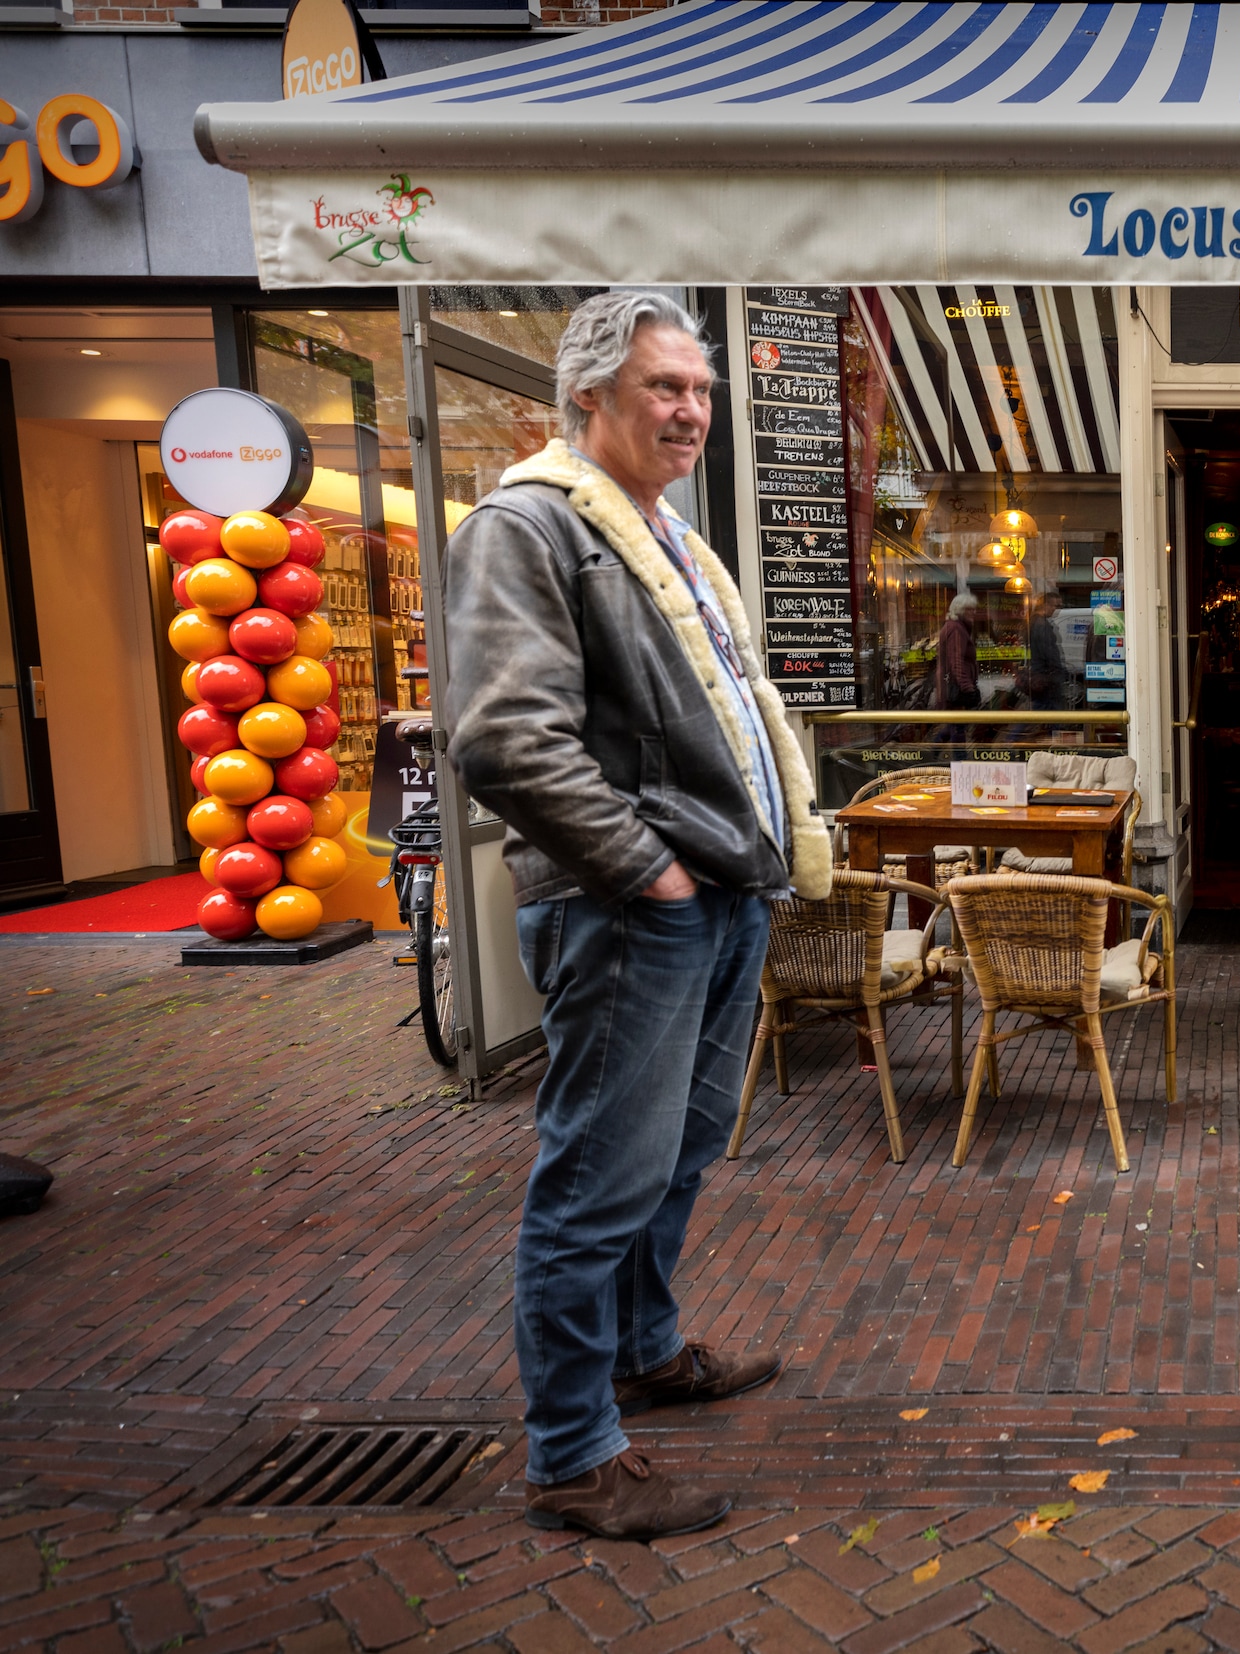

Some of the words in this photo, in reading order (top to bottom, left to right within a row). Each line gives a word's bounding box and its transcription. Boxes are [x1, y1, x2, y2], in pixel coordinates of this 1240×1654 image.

[309, 195, 382, 237] brugse
[328, 230, 432, 268] Zot
[945, 305, 1011, 318] CHOUFFE
[761, 312, 818, 330] KOMPAAN
[775, 410, 786, 420] de
[189, 449, 233, 460] vodafone
[773, 450, 824, 462] TREMENS
[768, 470, 812, 482] GULPENER
[771, 504, 832, 523] KASTEEL
[808, 549, 831, 557] BLOND
[767, 569, 816, 584] GUINNESS
[783, 660, 813, 673] BOK
[779, 691, 826, 703] ULPENER
[399, 767, 423, 785] 12
